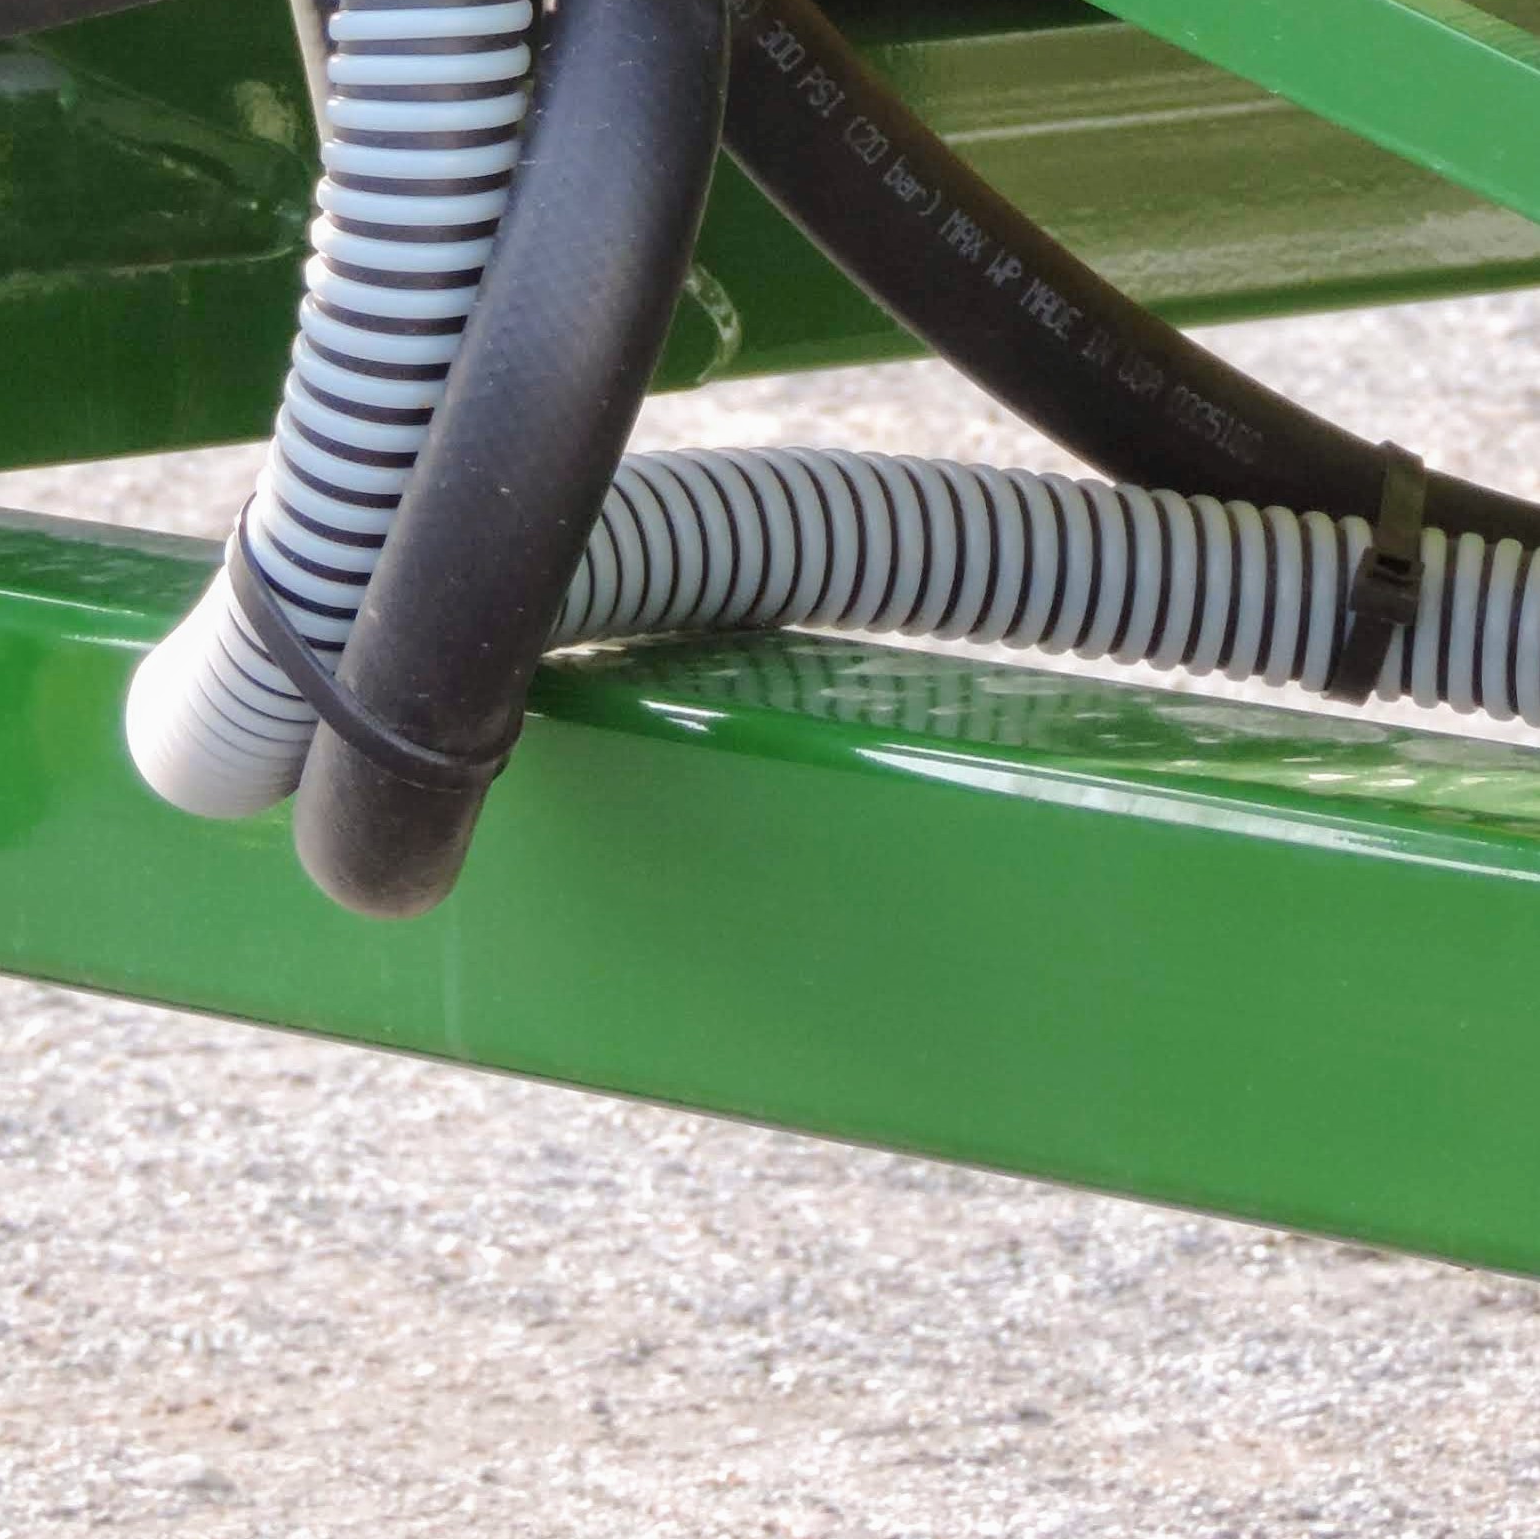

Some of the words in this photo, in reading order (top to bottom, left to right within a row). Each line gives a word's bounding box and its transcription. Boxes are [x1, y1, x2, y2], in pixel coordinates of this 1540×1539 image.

[757, 19, 806, 73] 300
[797, 65, 846, 118] PSI
[882, 154, 942, 217] bar)
[938, 209, 990, 264] MAX
